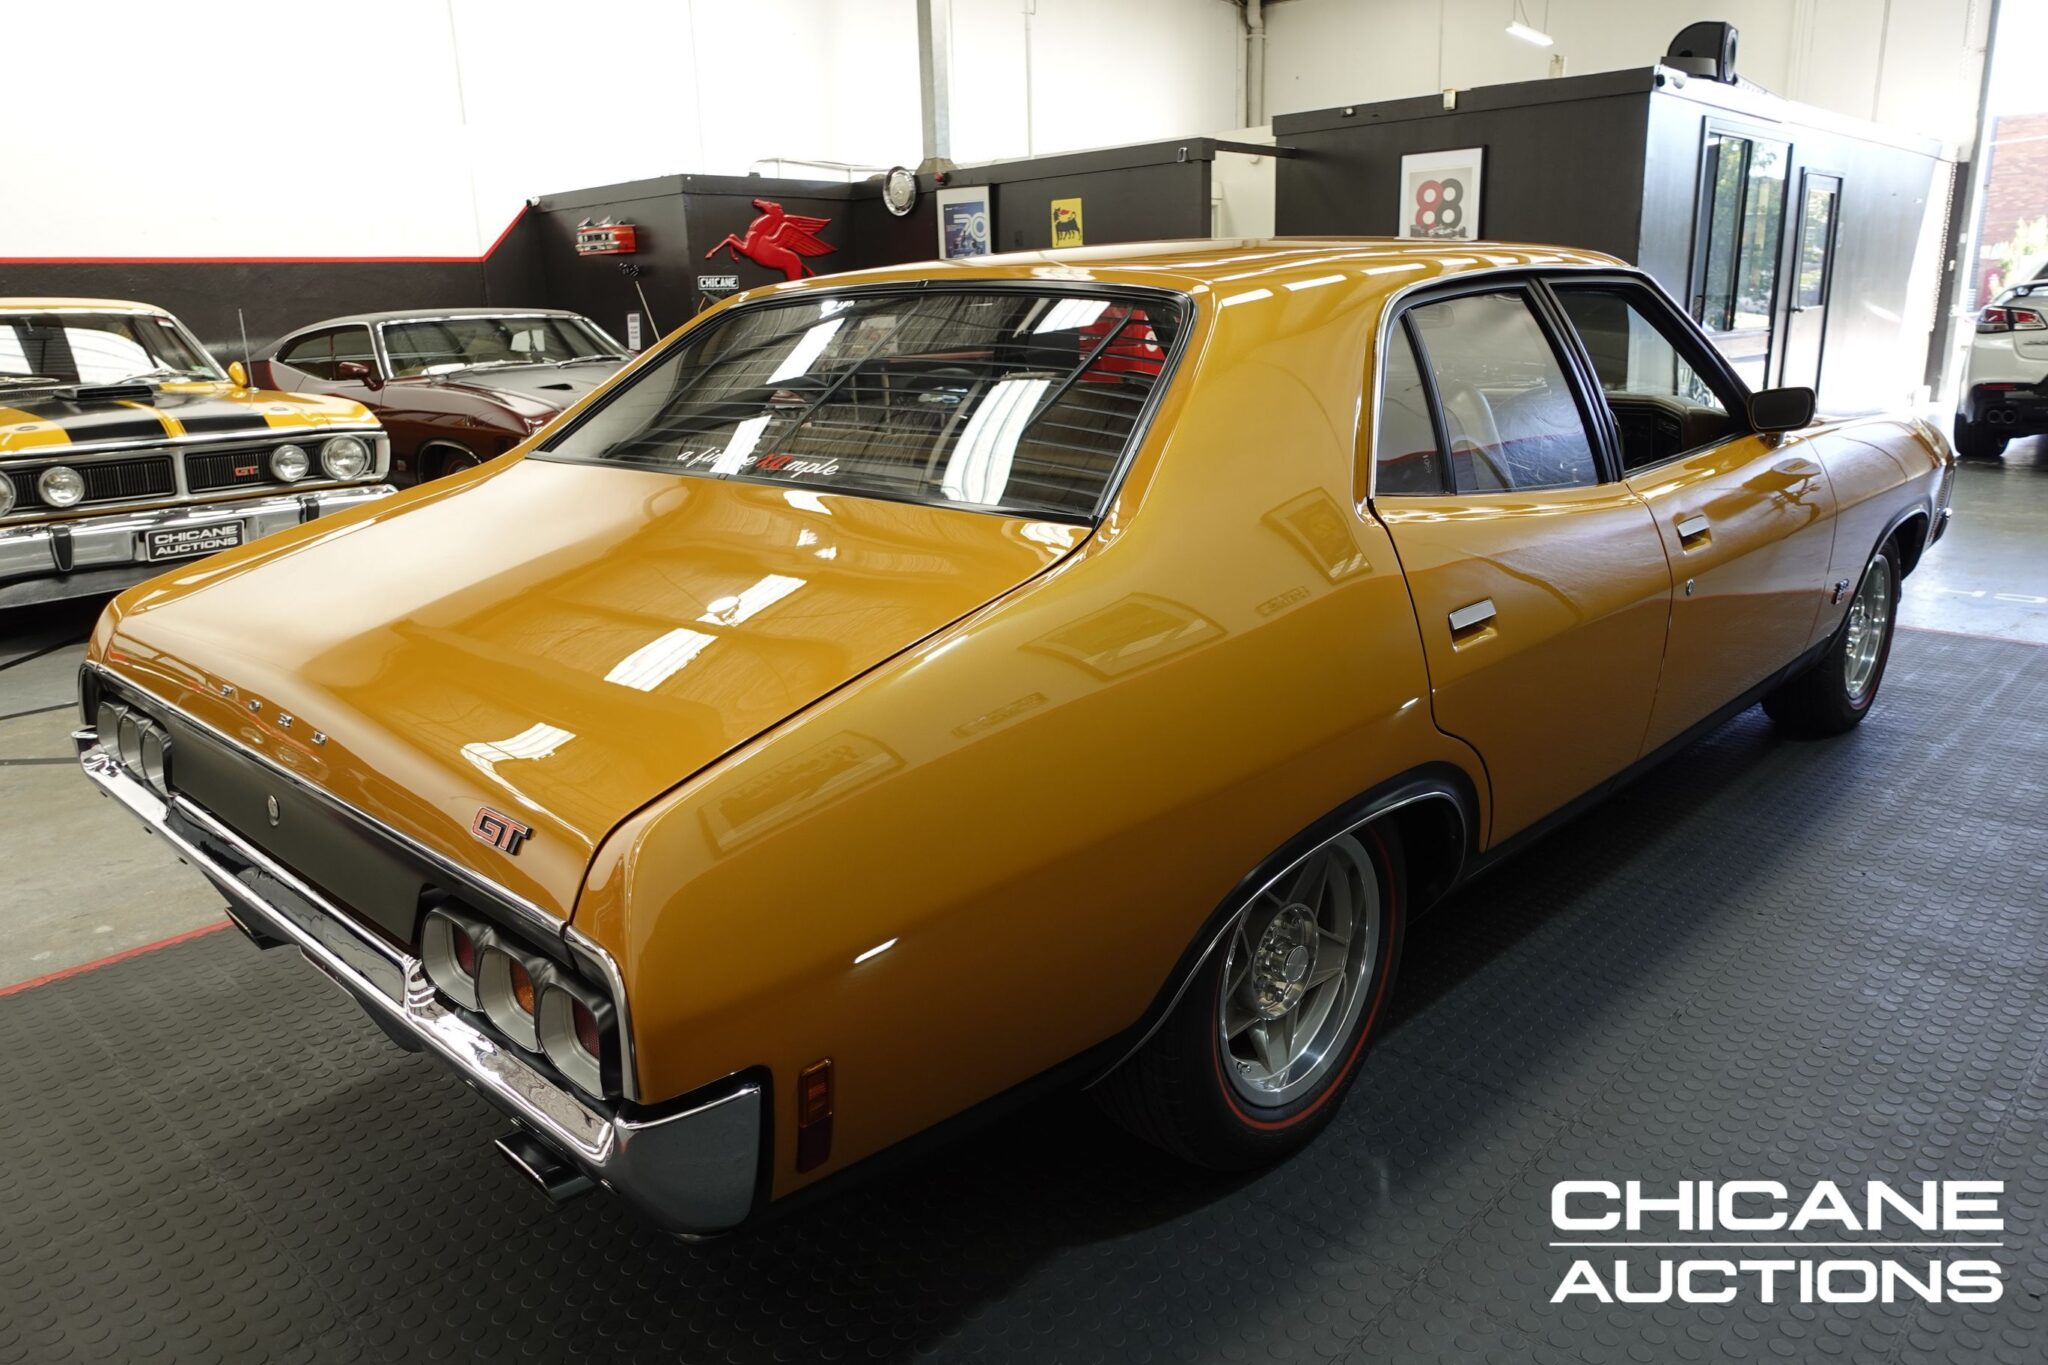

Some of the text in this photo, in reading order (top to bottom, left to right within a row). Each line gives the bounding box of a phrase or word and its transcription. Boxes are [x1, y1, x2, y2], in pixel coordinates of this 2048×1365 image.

[1415, 178, 1463, 230] 88
[700, 277, 737, 288] CHICANE
[676, 450, 694, 461] a
[235, 465, 259, 477] GT
[154, 525, 238, 545] CHICANE
[155, 536, 239, 556] AUCTIONS
[472, 807, 532, 854] GT
